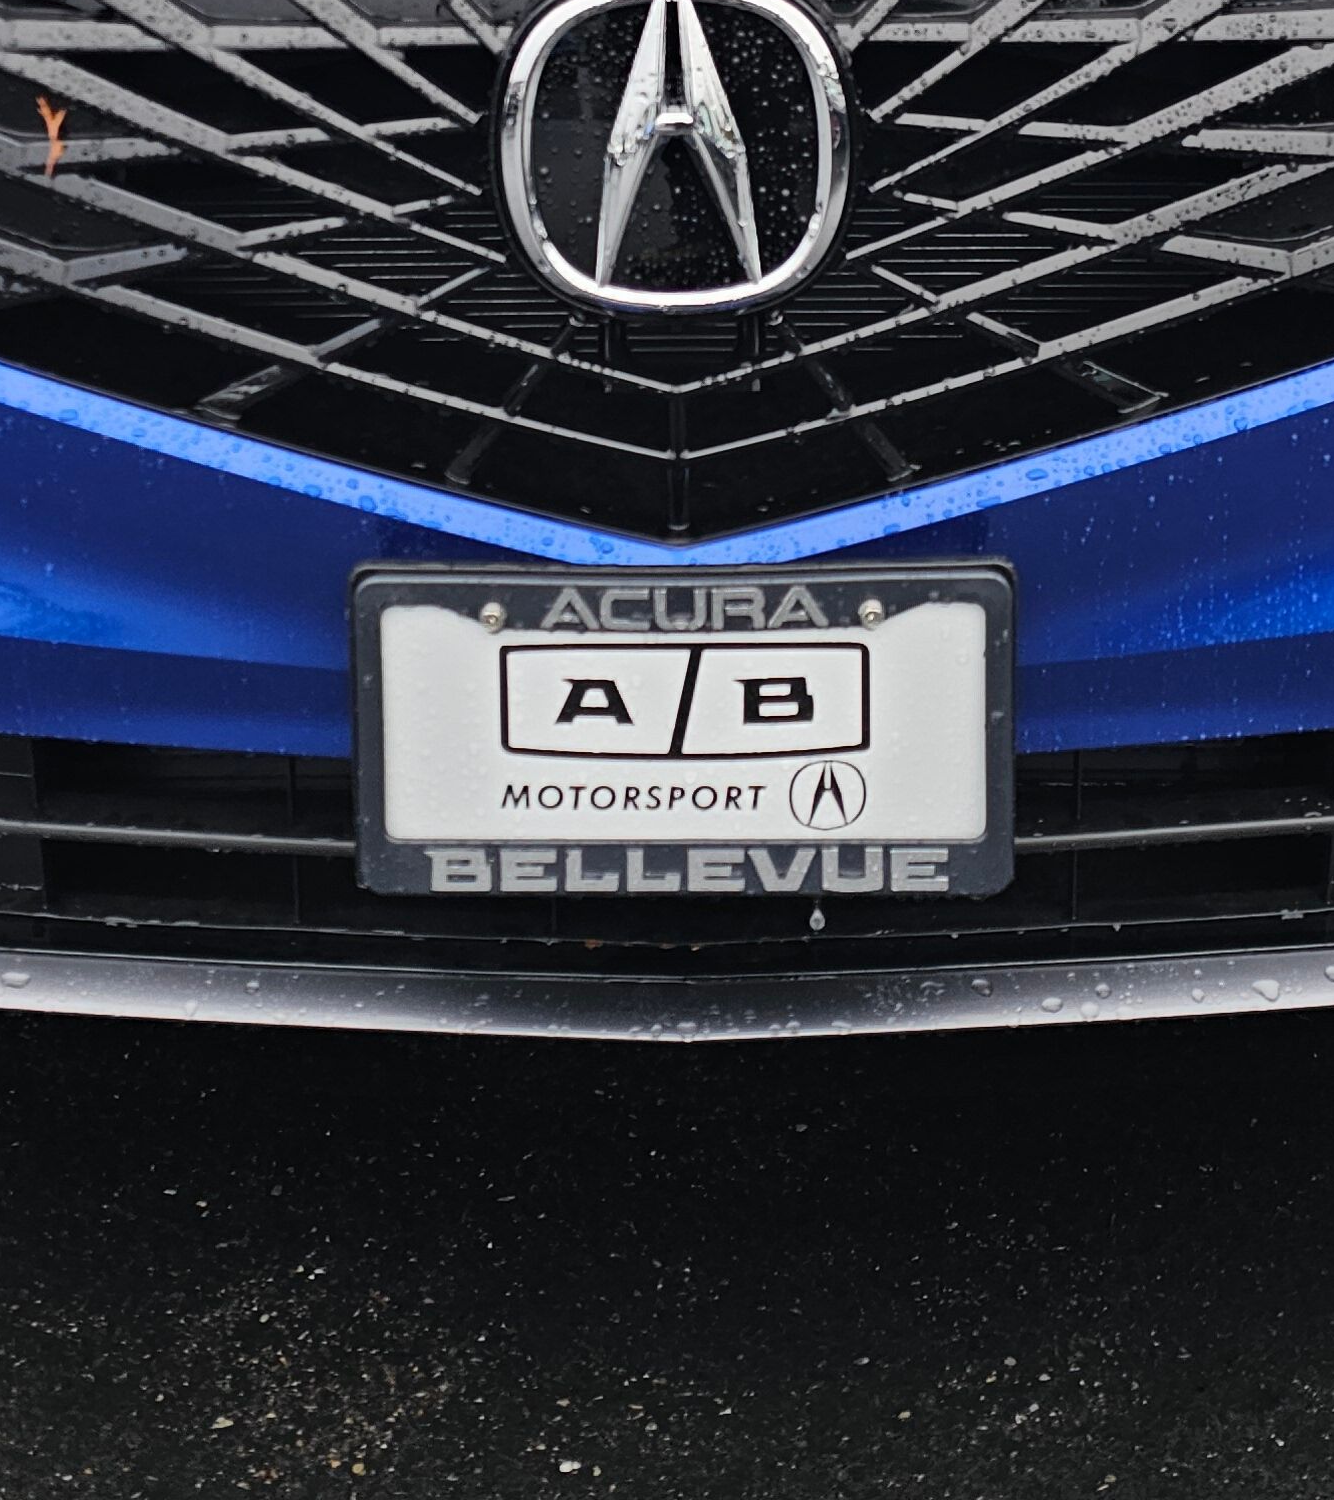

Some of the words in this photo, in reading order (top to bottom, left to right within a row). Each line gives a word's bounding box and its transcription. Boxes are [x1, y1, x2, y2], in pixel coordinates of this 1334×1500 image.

[540, 584, 829, 632] ACURA
[554, 678, 634, 726] A
[734, 675, 815, 725] B
[501, 784, 768, 812] MOTORSPORT
[423, 847, 950, 894] BELLEVUE
